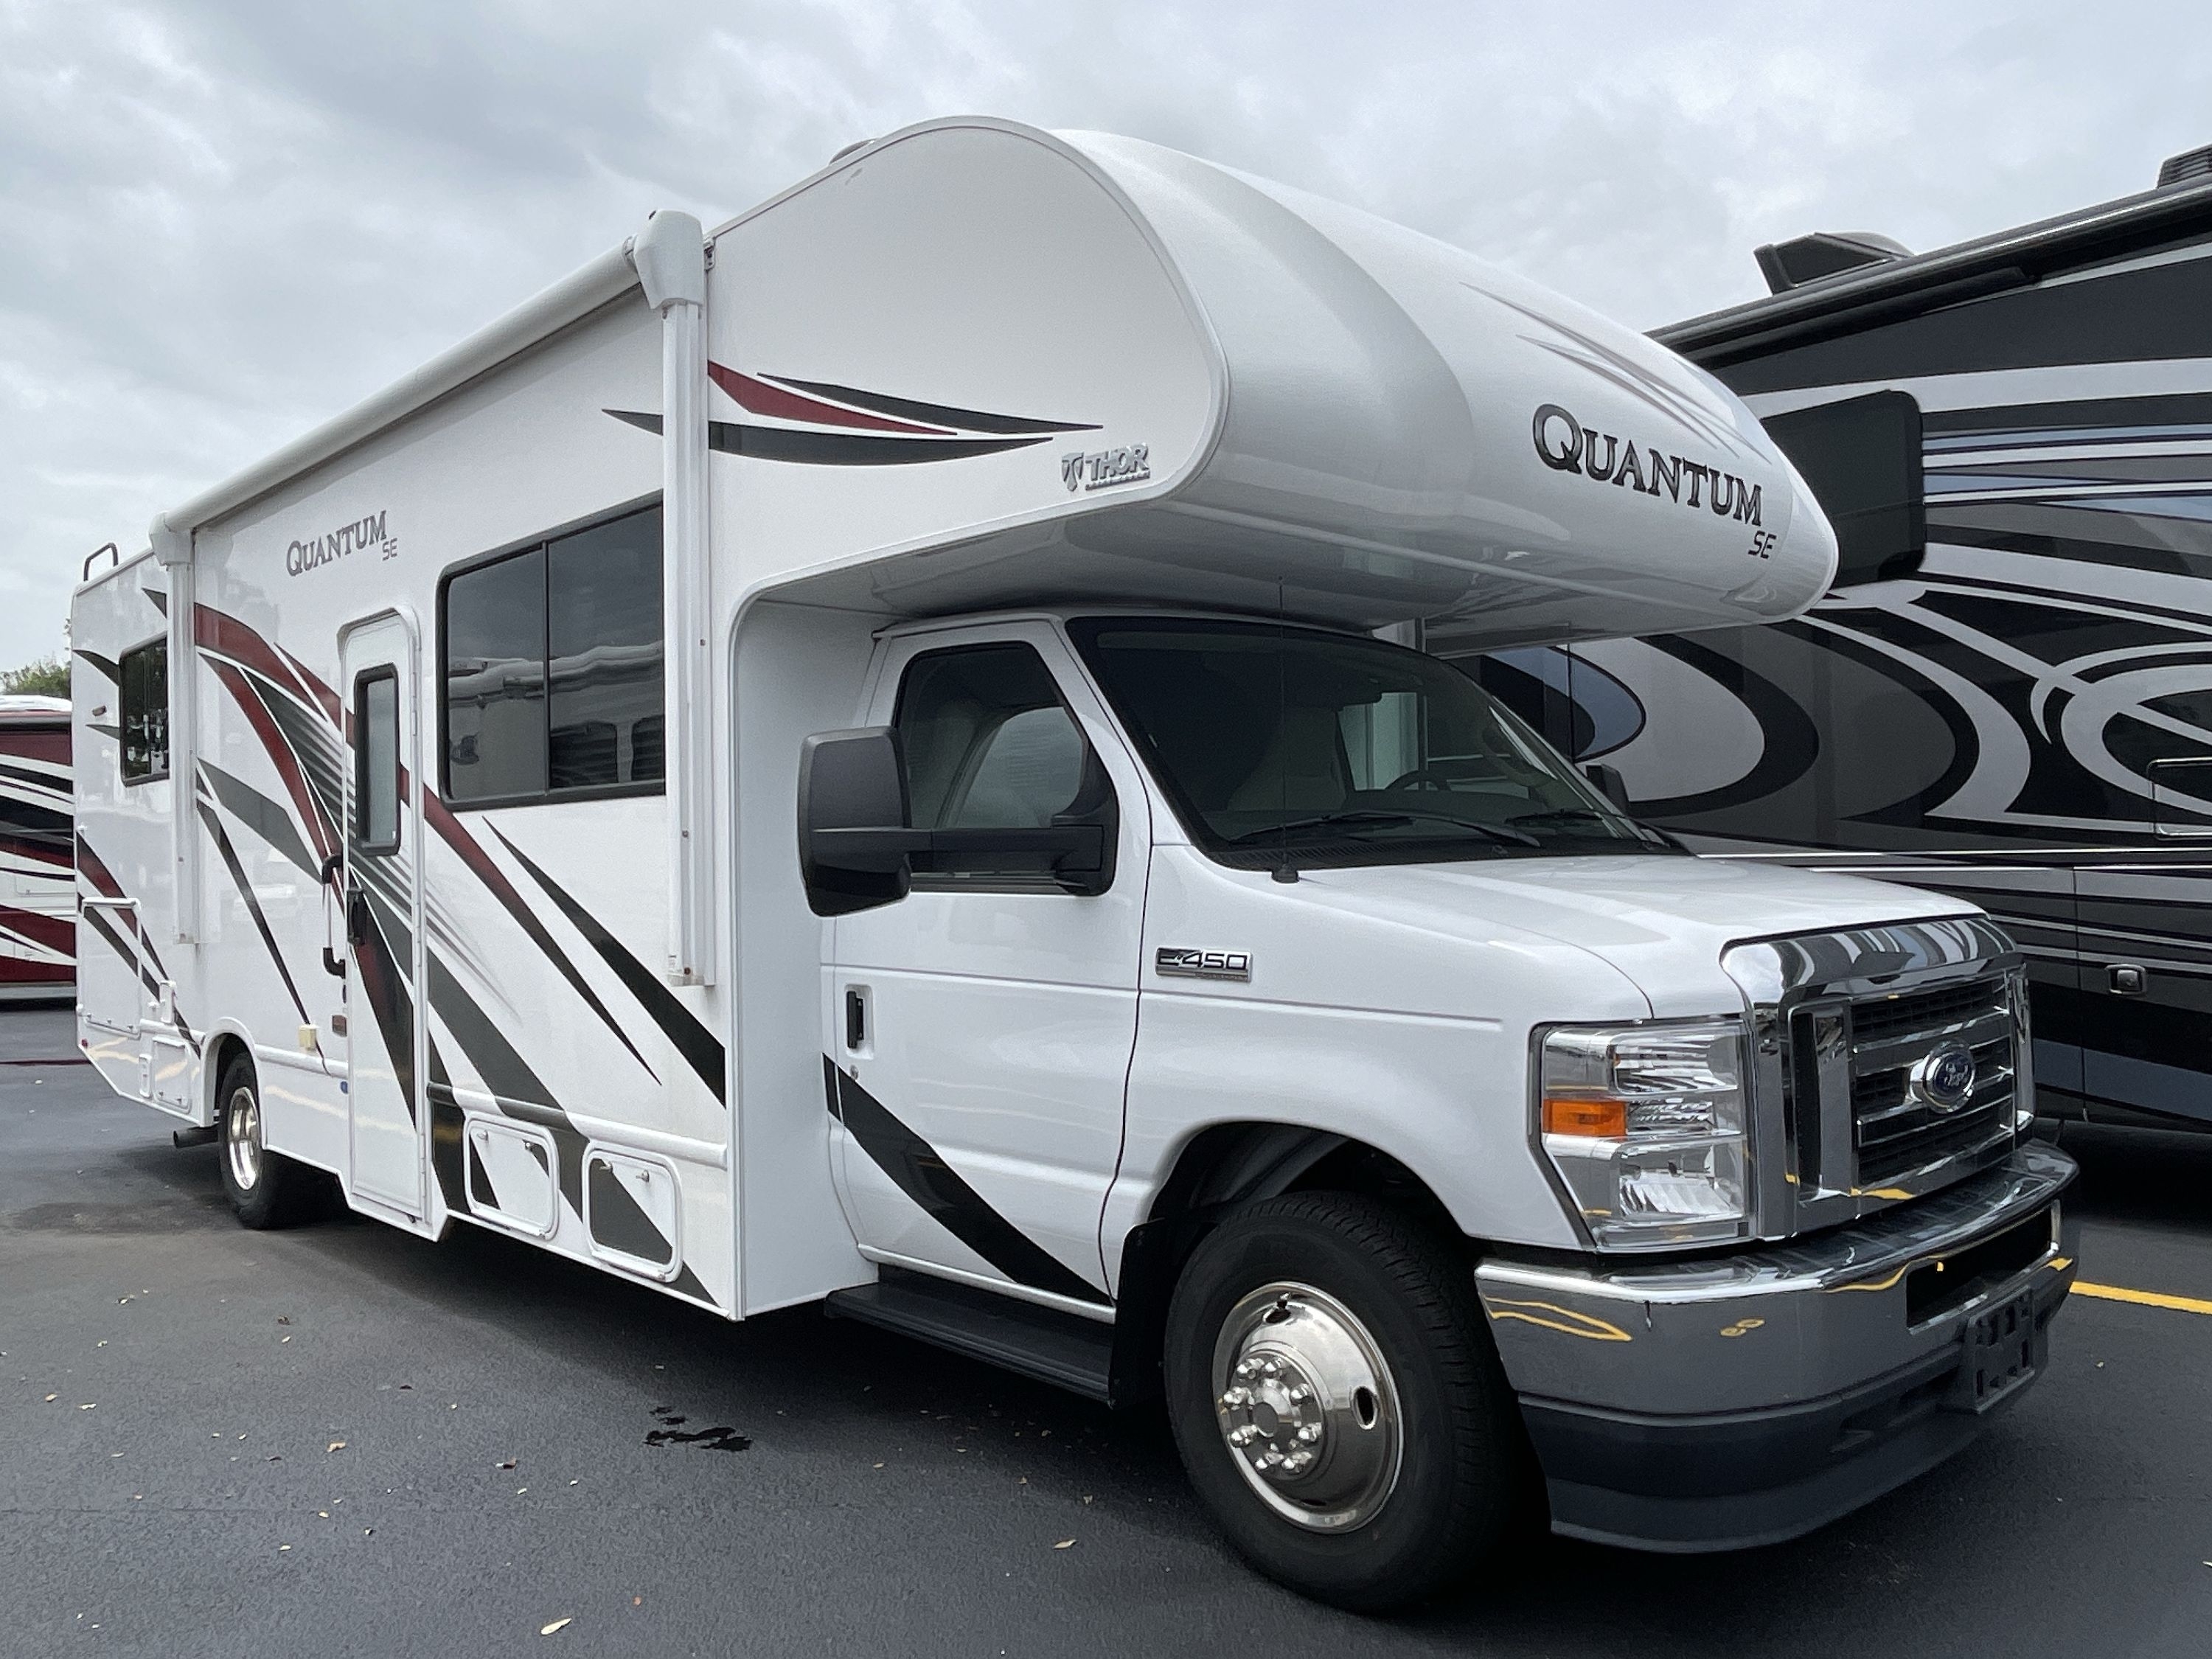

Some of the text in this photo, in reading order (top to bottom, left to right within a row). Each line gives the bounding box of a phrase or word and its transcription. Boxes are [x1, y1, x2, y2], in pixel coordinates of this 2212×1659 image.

[1085, 442, 1149, 481] THOR
[1533, 403, 1761, 526] QUANTUM
[286, 509, 386, 577] QUANTUM
[382, 538, 398, 561] SE
[1747, 530, 1777, 559] SE
